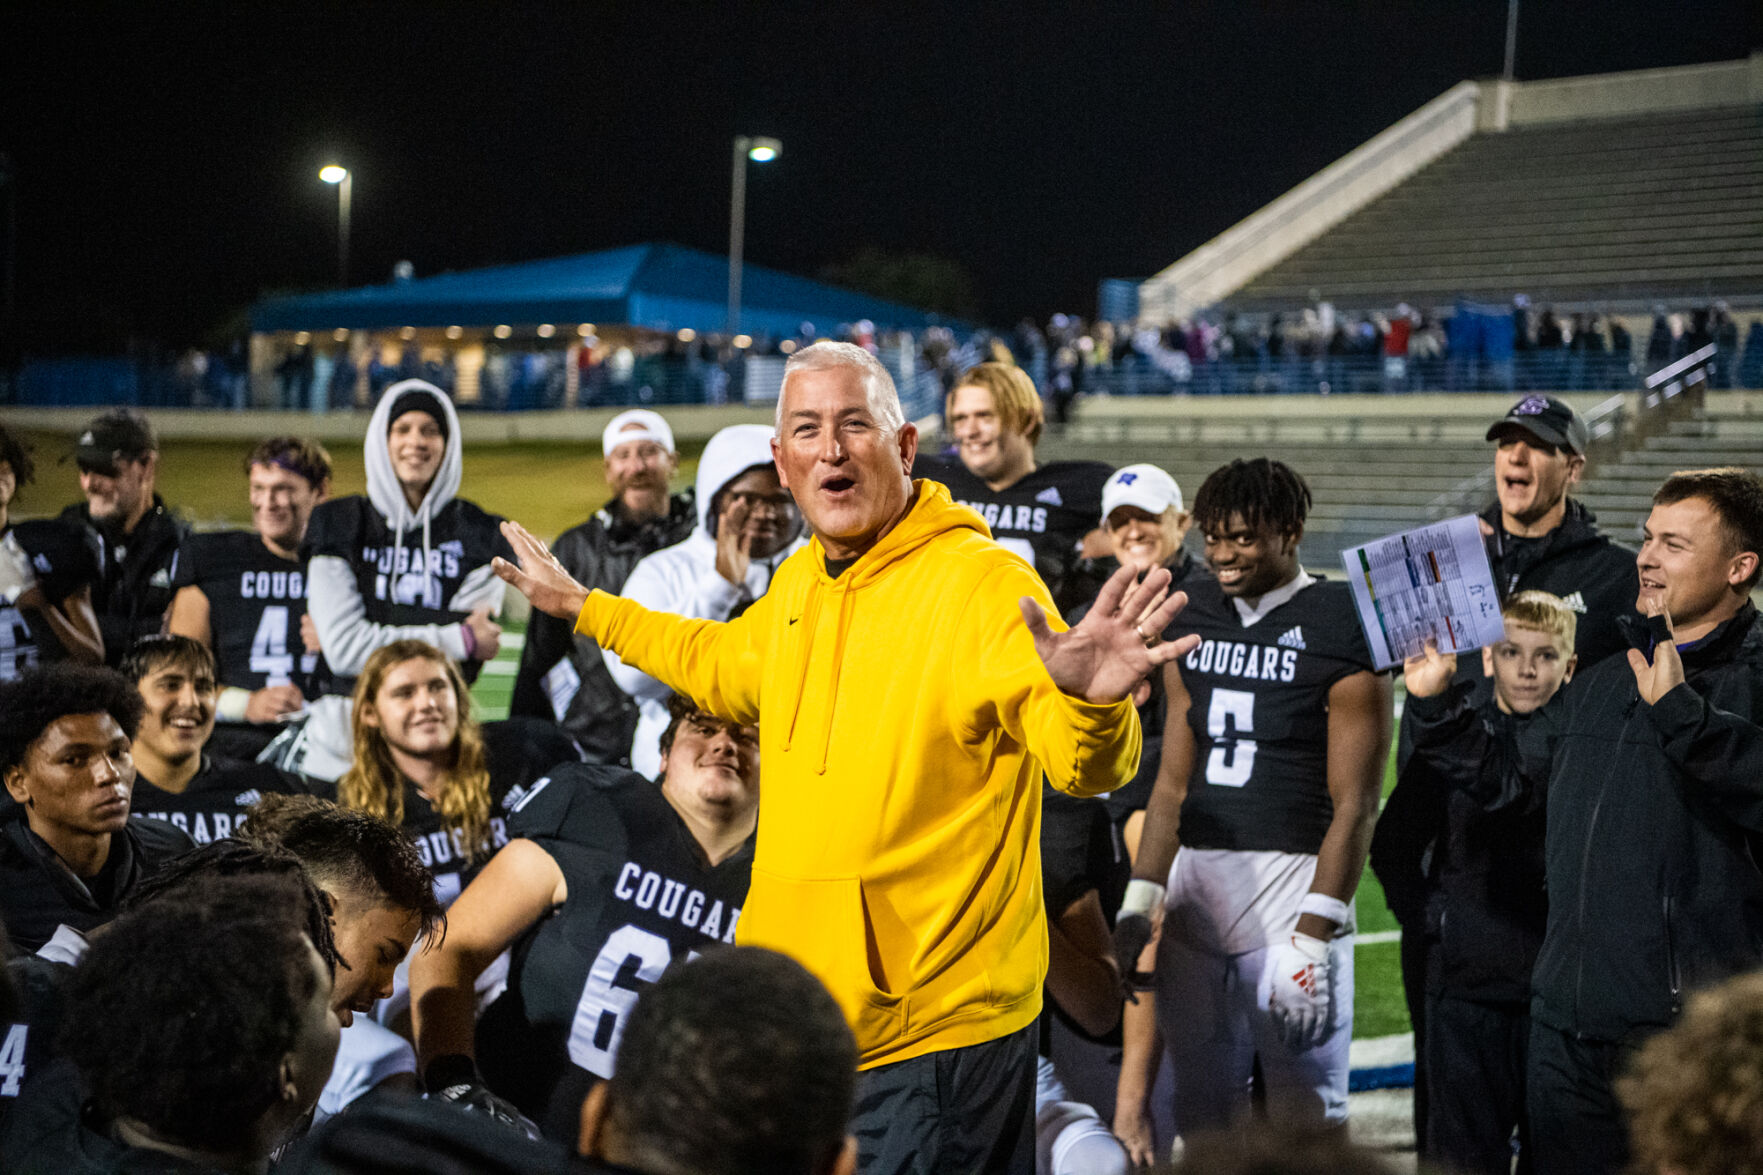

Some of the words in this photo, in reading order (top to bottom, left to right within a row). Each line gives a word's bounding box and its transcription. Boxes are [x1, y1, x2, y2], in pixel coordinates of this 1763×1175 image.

[957, 500, 1048, 533] GARS
[241, 571, 310, 599] COUG
[250, 606, 318, 688] 4
[567, 924, 702, 1081] 6
[0, 1024, 29, 1097] 4
